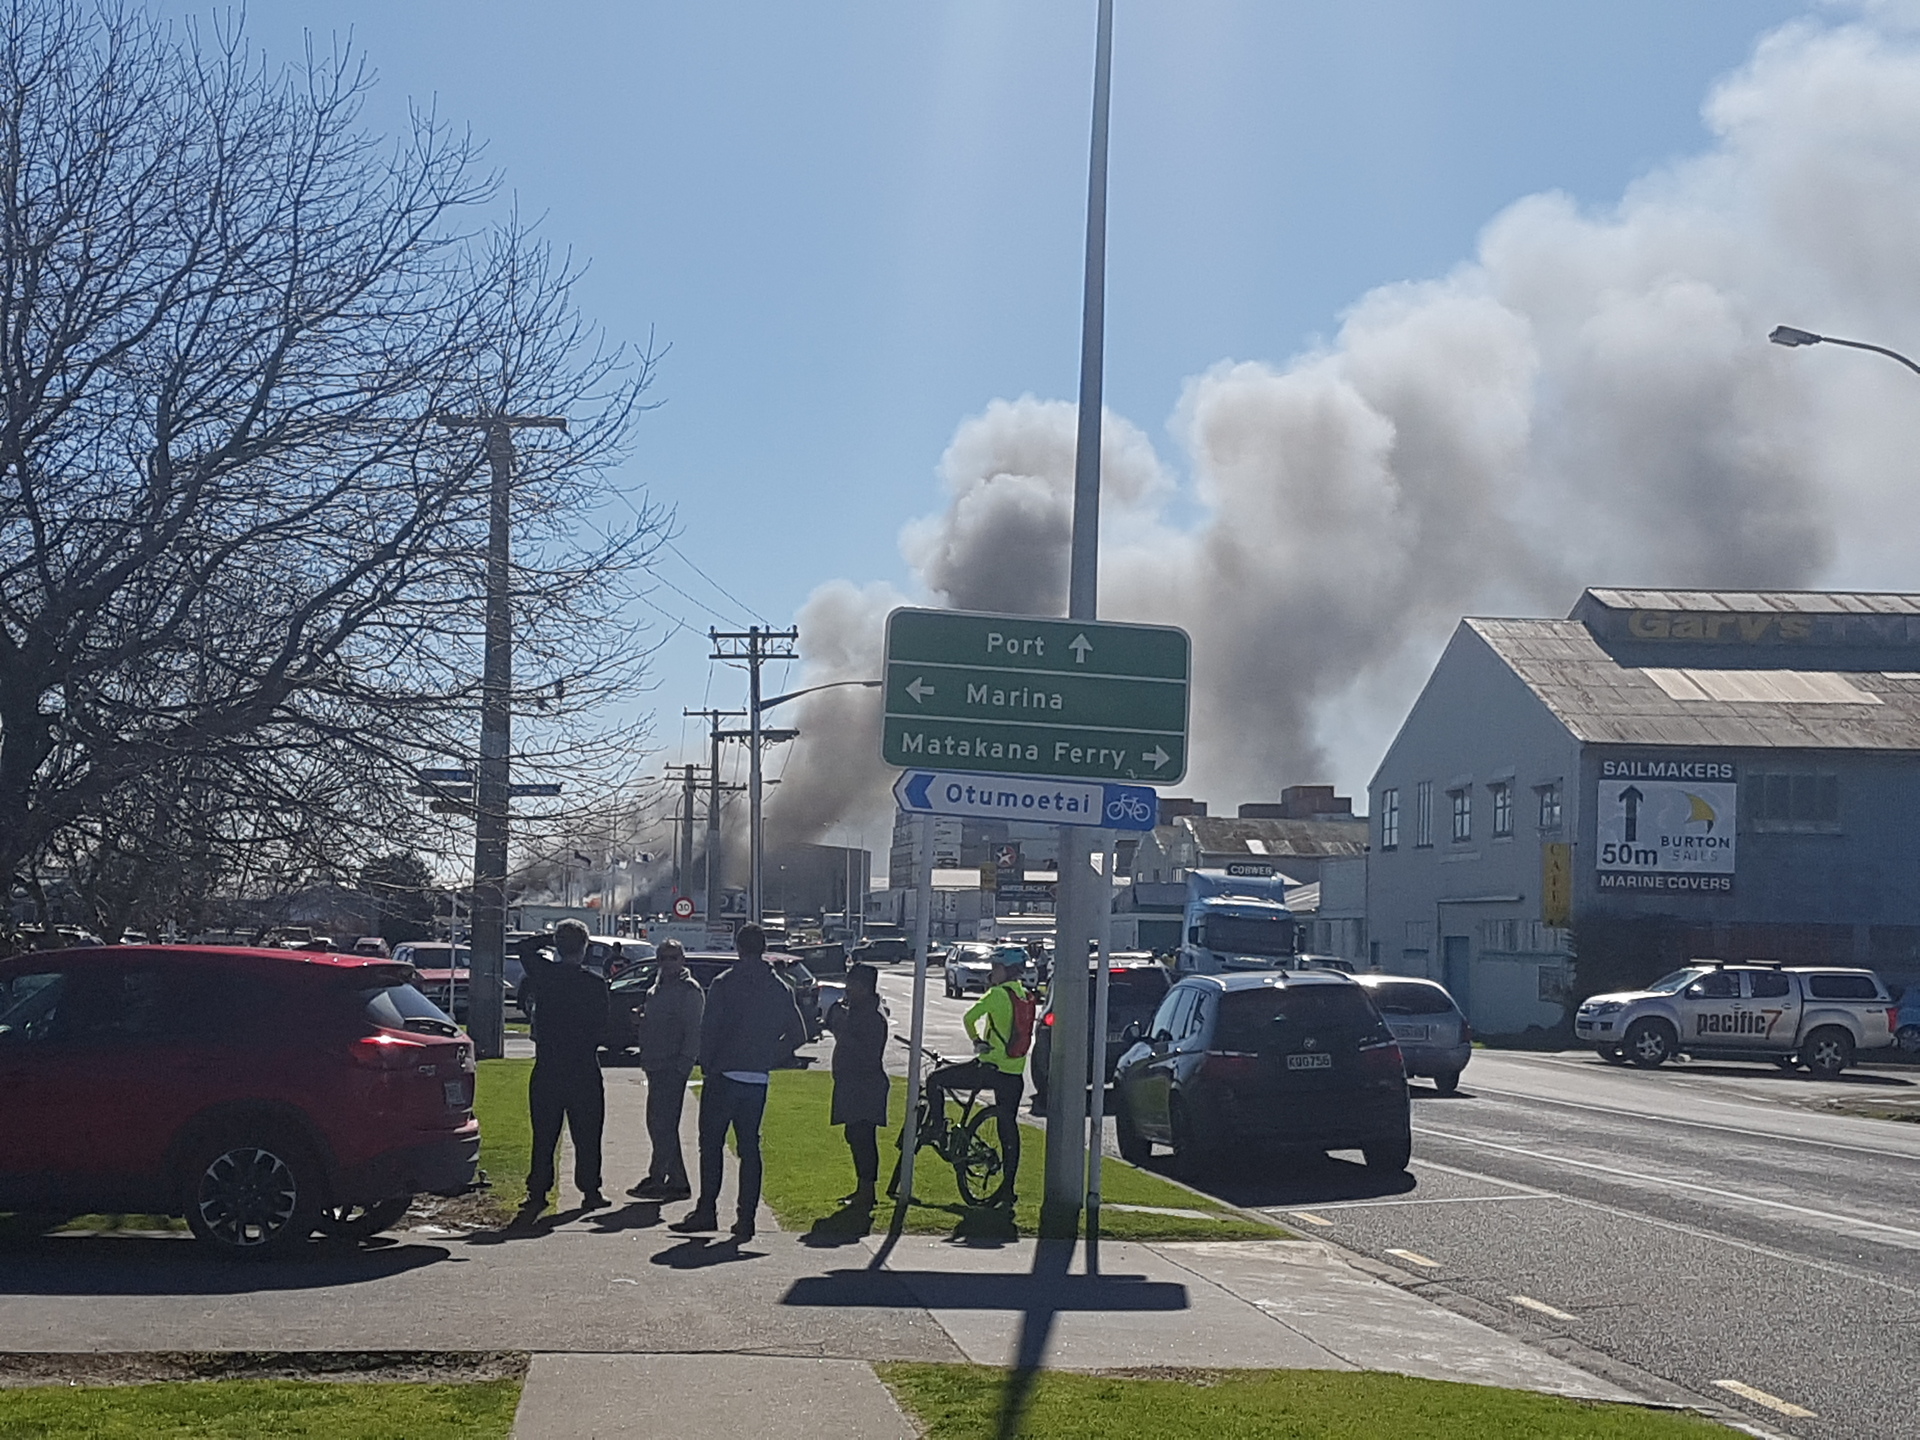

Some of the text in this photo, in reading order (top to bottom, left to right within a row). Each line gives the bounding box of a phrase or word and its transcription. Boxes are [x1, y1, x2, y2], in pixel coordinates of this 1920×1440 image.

[987, 632, 1045, 656] Port
[966, 683, 1064, 710] Marina
[901, 732, 1127, 770] Matakana Ferry
[1603, 761, 1733, 779] SAILMAKERS
[945, 783, 1091, 813] Otumoetai
[1660, 835, 1731, 849] BURTON
[1601, 843, 1659, 867] 50m
[1671, 850, 1719, 862] SAILS
[1600, 875, 1732, 891] MARINE COVERS
[678, 903, 690, 911] 30
